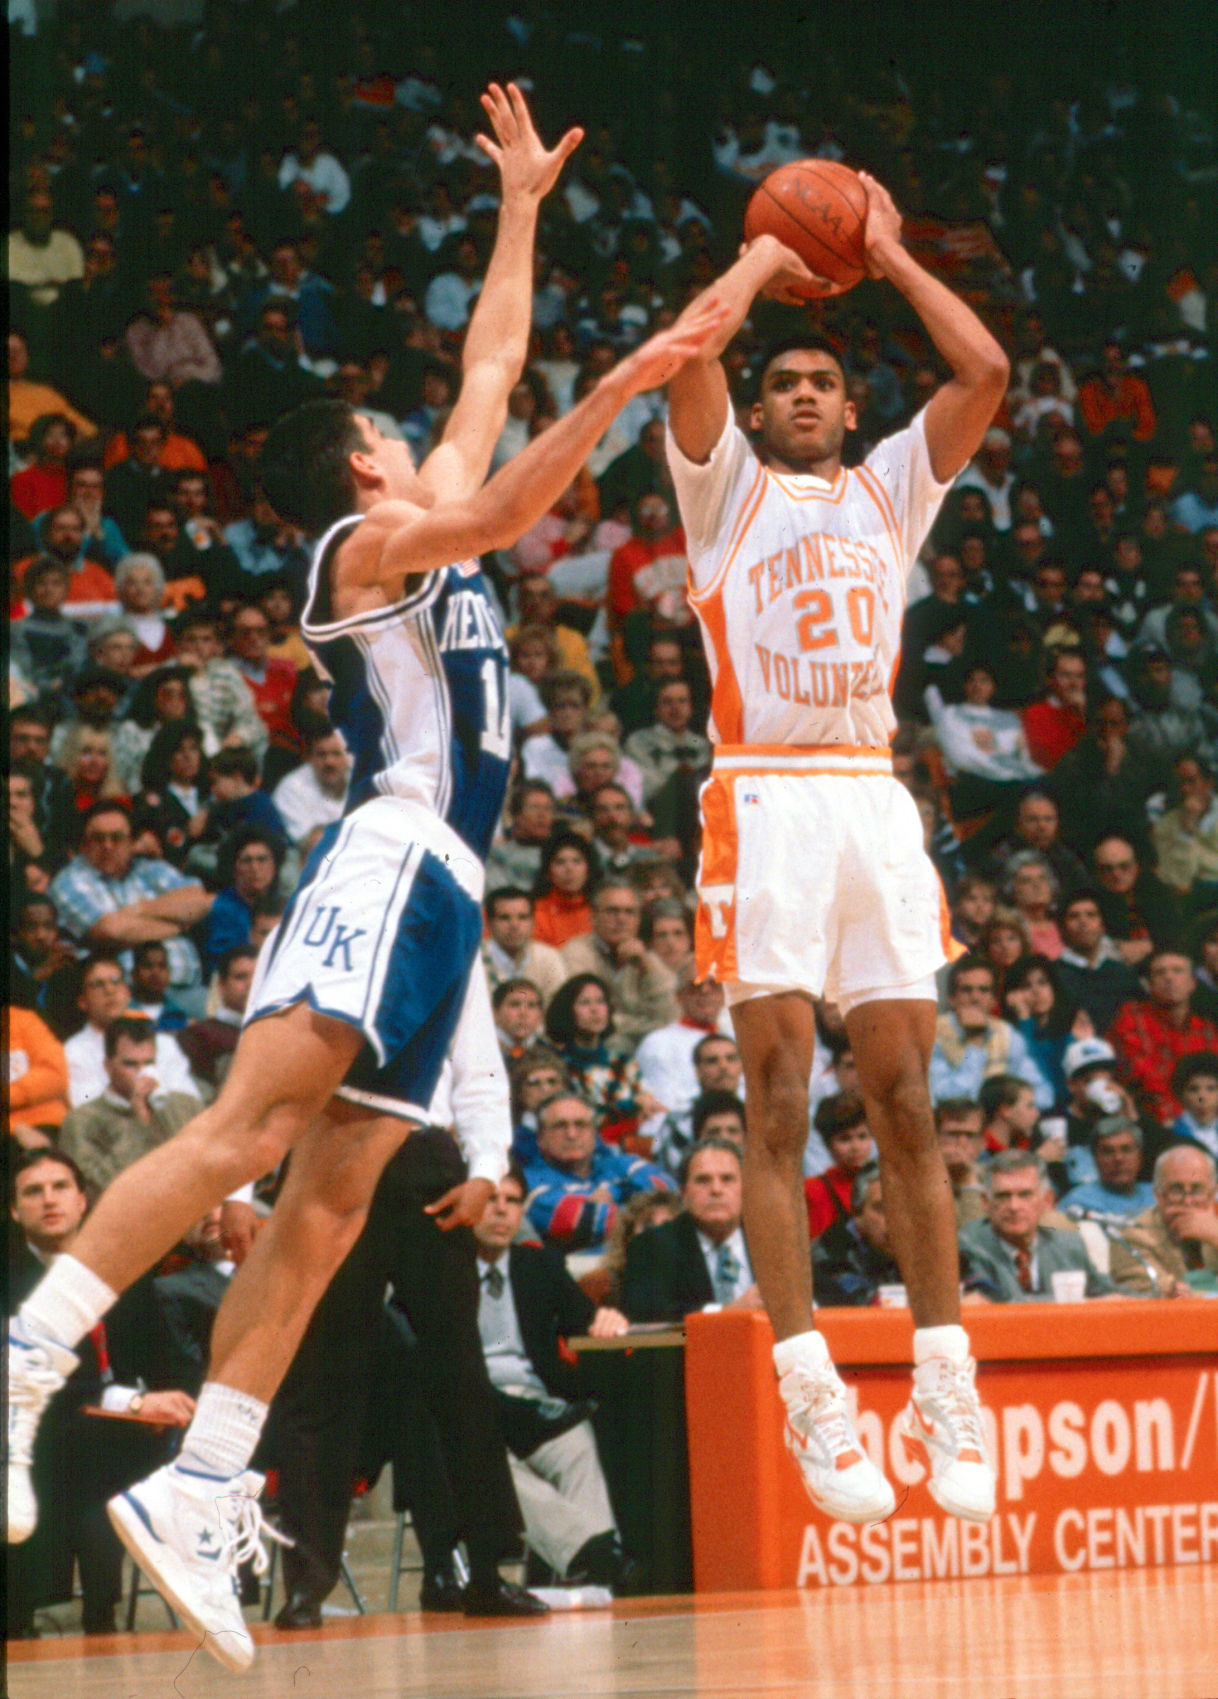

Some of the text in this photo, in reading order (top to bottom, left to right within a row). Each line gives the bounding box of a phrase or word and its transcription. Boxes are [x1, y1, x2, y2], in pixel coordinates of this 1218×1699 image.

[793, 585, 875, 654] 20
[303, 906, 367, 972] UK
[797, 1503, 1218, 1587] ASSEMBLY CENTER
